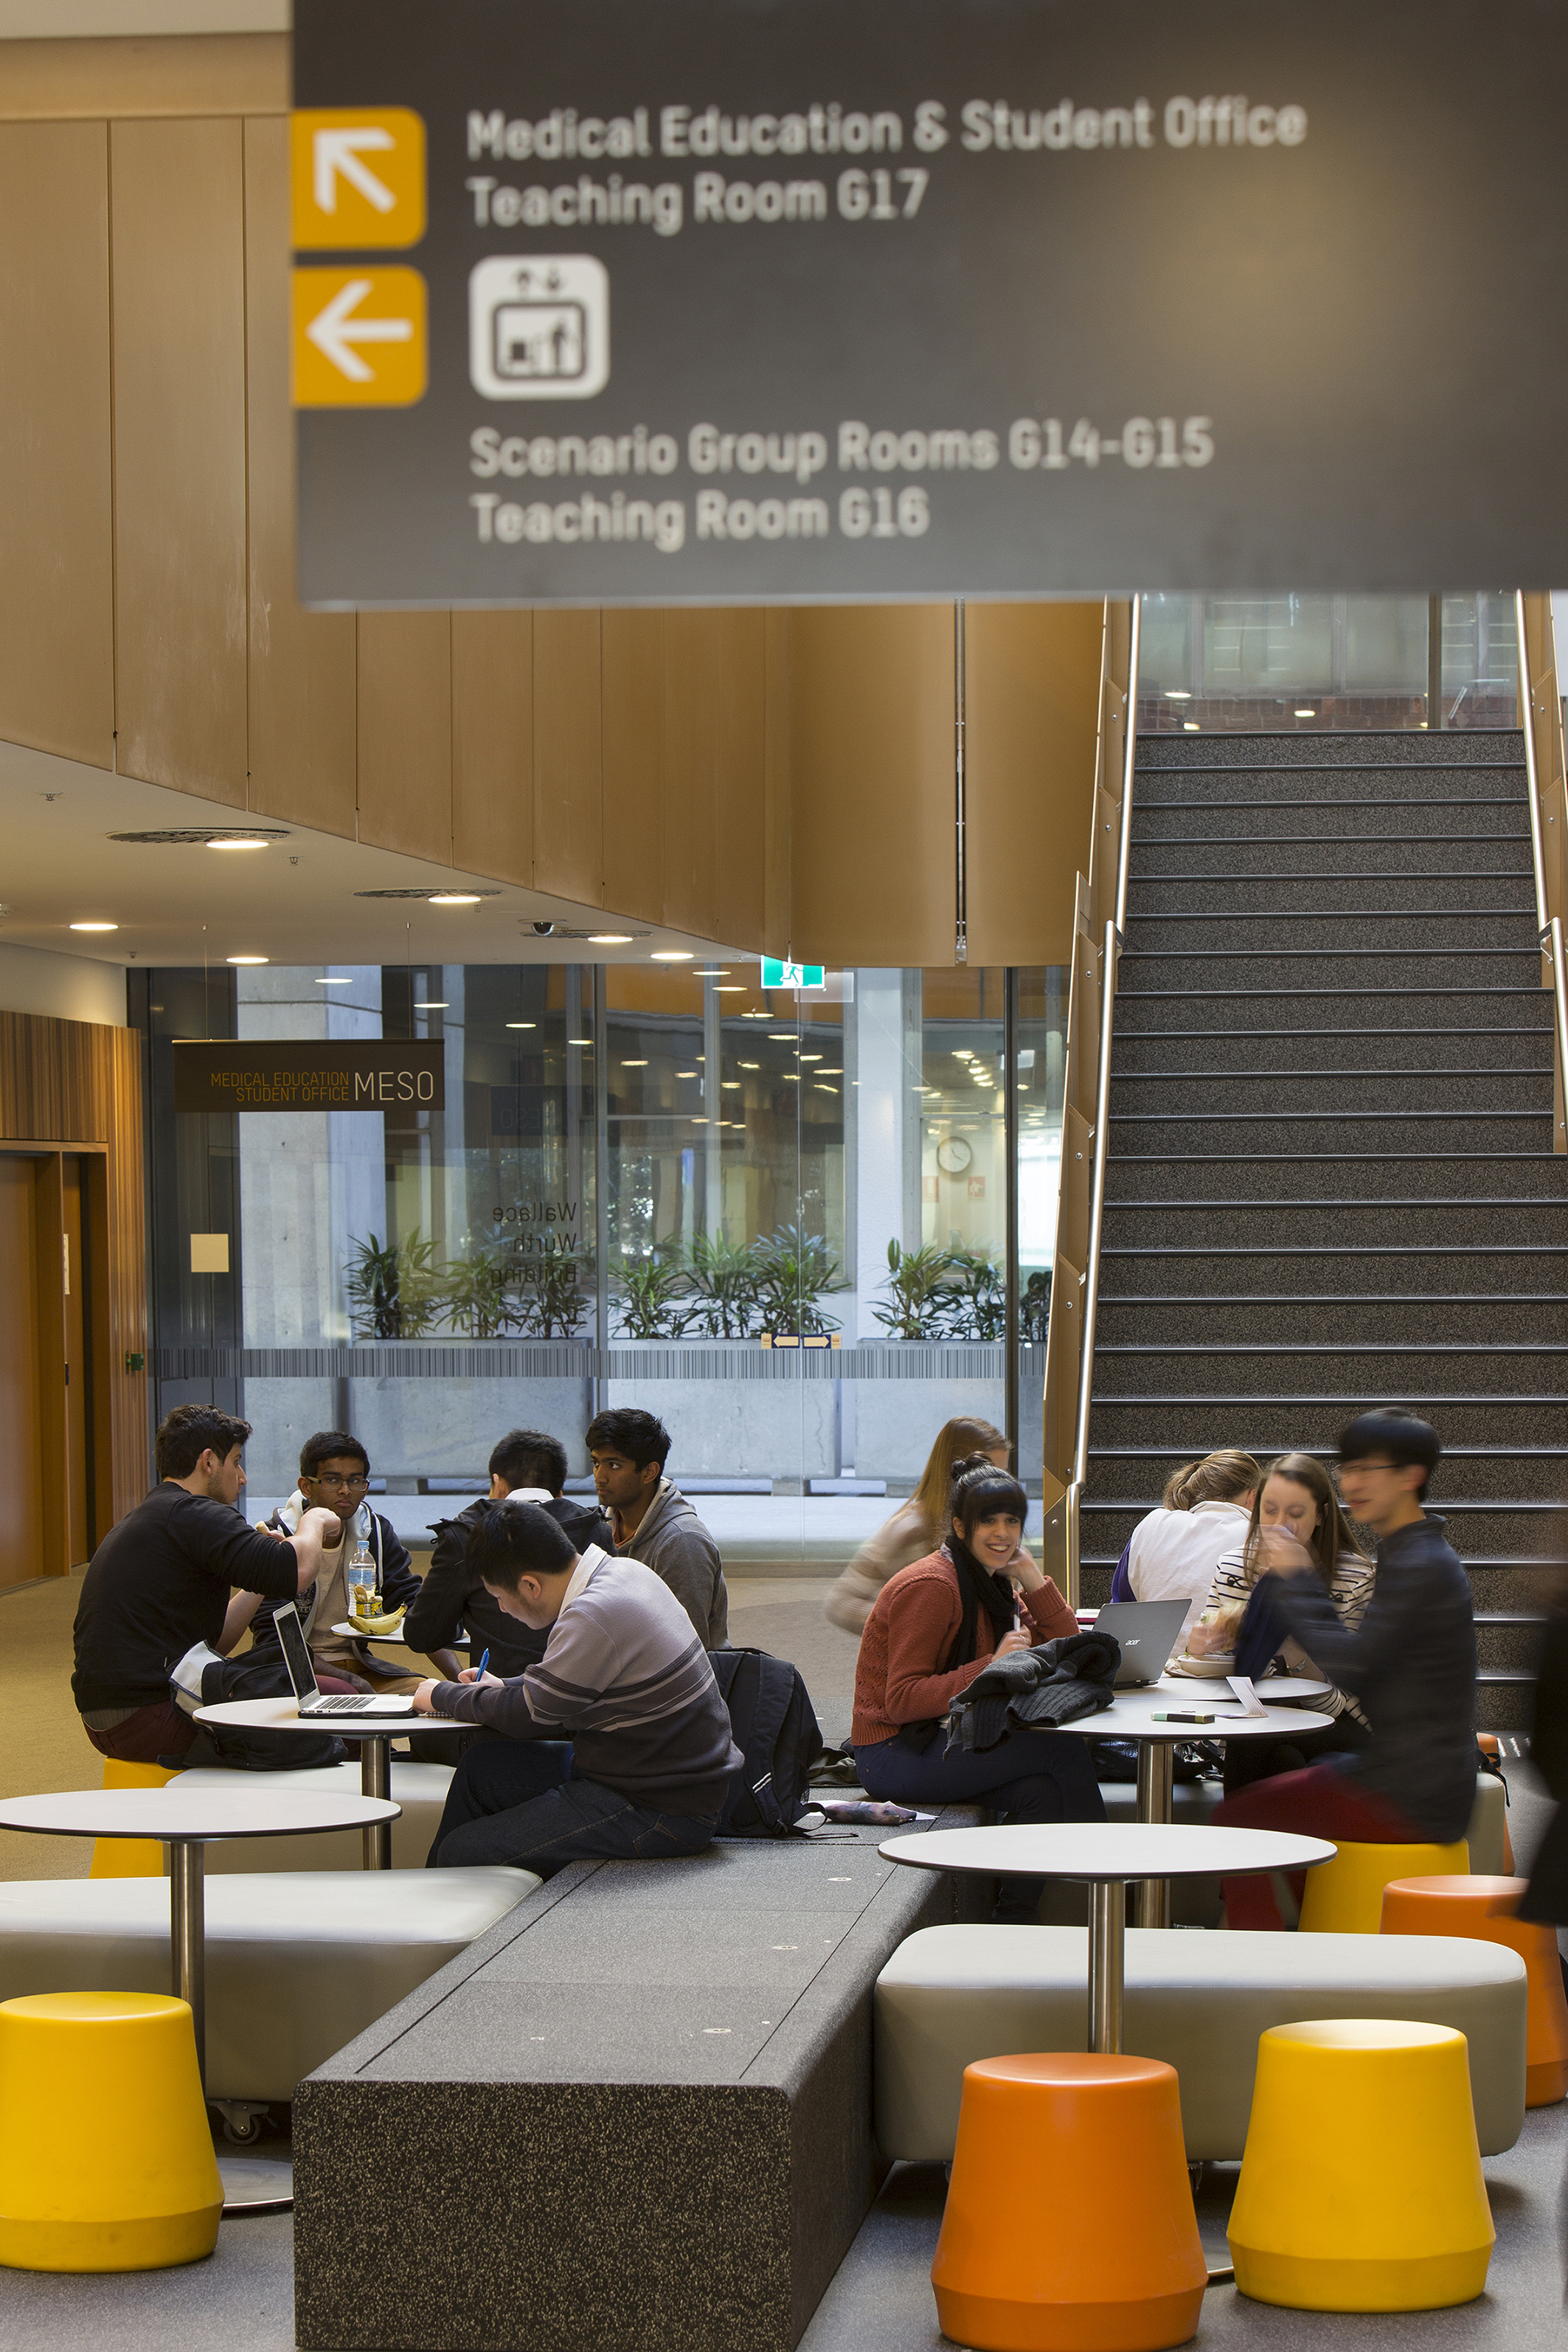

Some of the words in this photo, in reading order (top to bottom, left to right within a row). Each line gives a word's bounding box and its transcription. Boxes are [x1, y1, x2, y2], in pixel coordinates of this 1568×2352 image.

[467, 106, 652, 159] Medical
[660, 103, 903, 157] Education
[912, 100, 949, 152] &
[961, 97, 1154, 152] Student
[1164, 94, 1308, 148] Office
[466, 174, 683, 236] Teaching
[693, 171, 828, 223] Room
[836, 167, 930, 221] G17
[470, 423, 679, 478] Scenario
[687, 422, 828, 486] Group
[838, 420, 1000, 472] Rooms
[1008, 416, 1215, 470] G14-G15
[470, 491, 687, 554] Teaching
[695, 488, 829, 540] Room
[838, 485, 931, 539] G16
[211, 1073, 269, 1087] MEDICAL
[274, 1072, 349, 1086] EDUCATION
[236, 1087, 297, 1101] STUDENT
[302, 1087, 349, 1101] OFFICE
[355, 1071, 434, 1101] MESO
